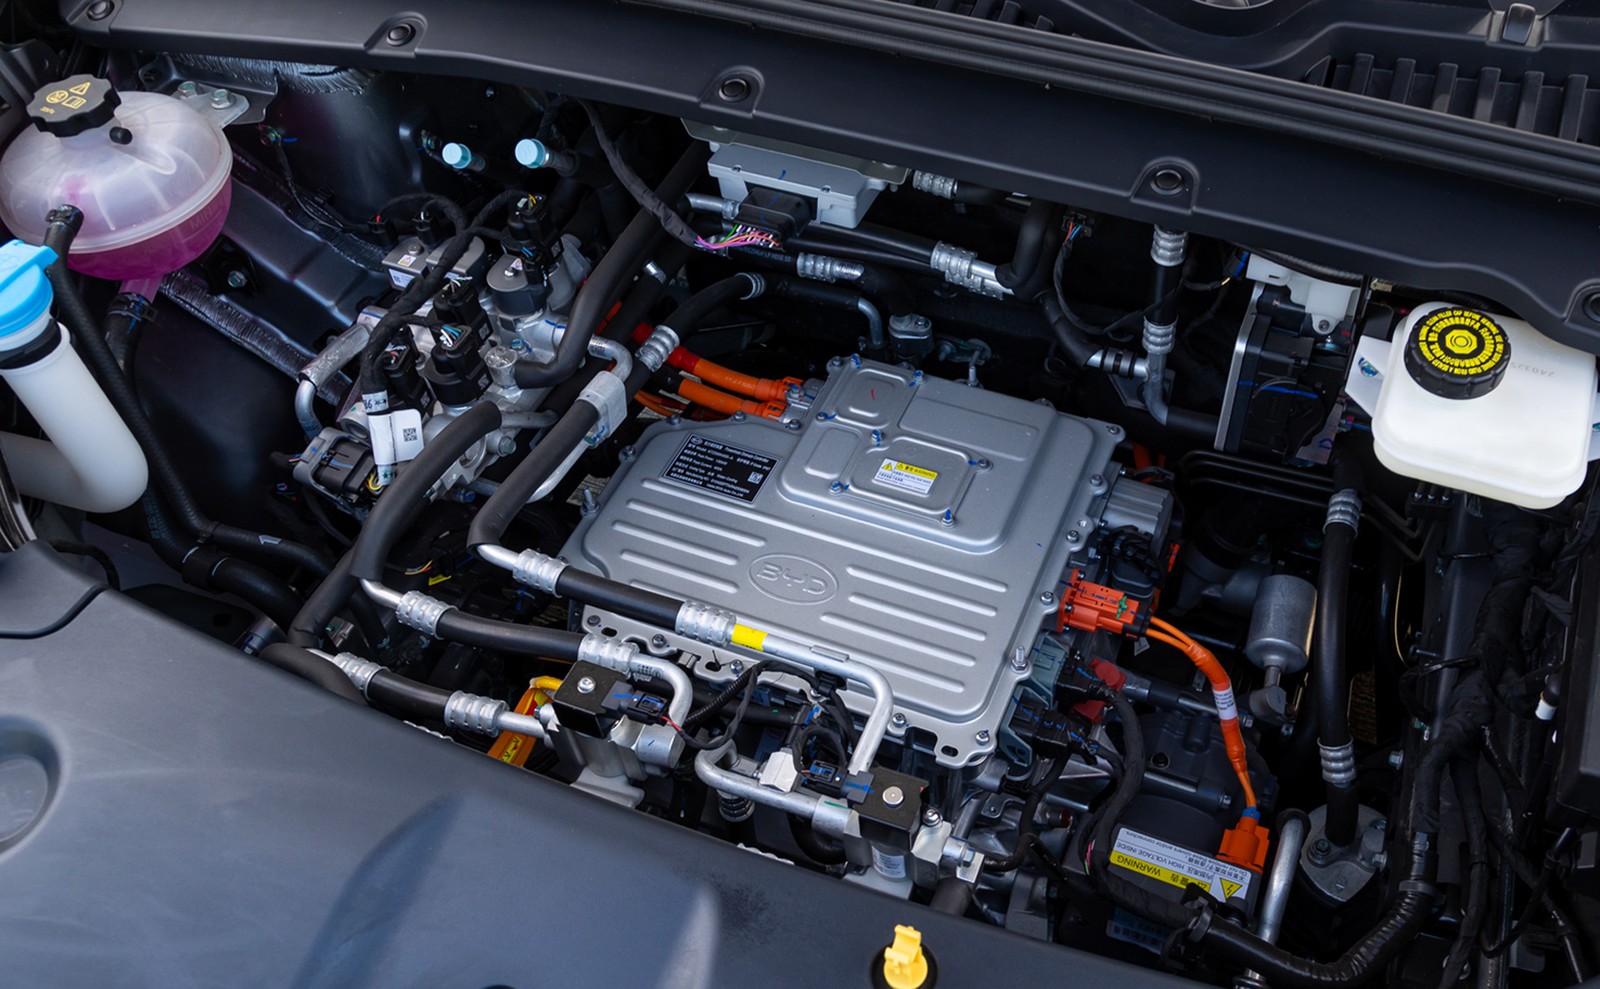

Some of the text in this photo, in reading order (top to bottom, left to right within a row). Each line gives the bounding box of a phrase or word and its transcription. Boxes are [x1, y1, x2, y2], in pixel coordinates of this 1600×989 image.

[755, 561, 828, 596] BYD
[1116, 841, 1136, 852] INSIDE
[1137, 849, 1167, 863] VOLTAGE
[1116, 854, 1160, 876] WARNING
[1168, 860, 1184, 869] HIGH
